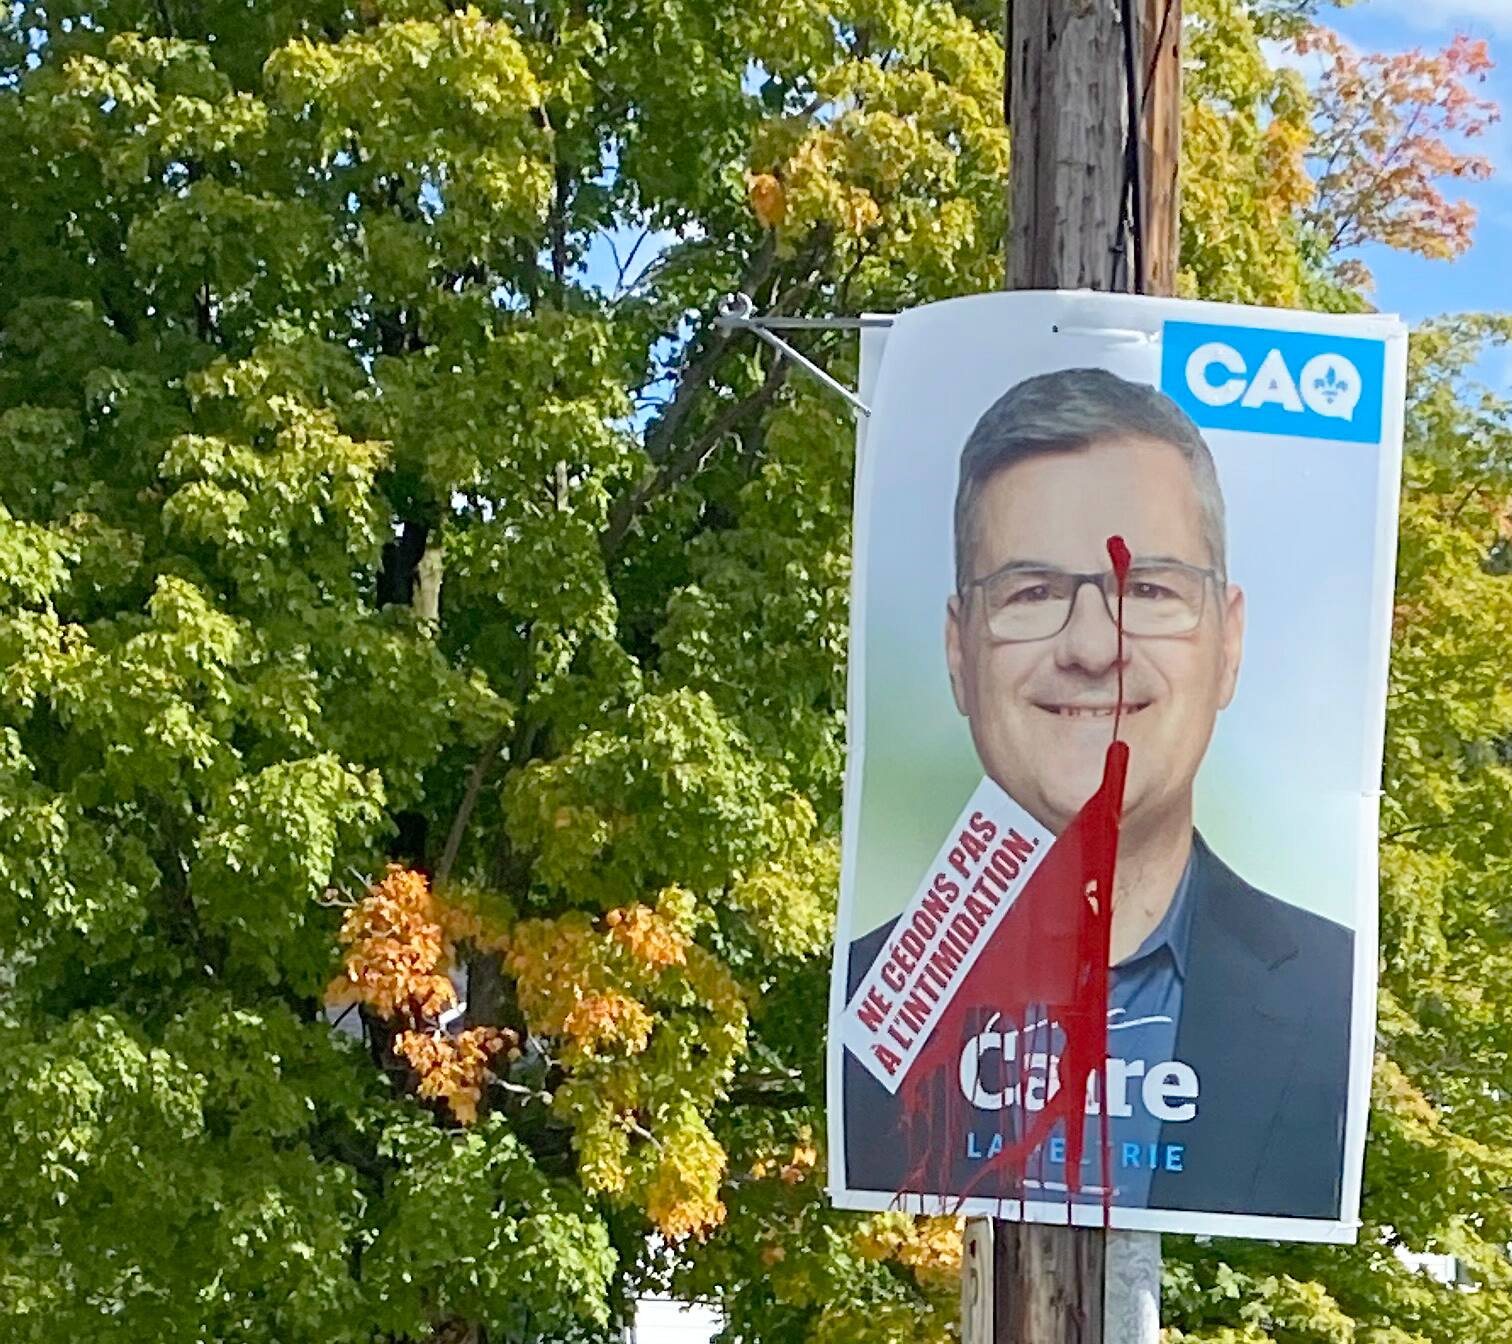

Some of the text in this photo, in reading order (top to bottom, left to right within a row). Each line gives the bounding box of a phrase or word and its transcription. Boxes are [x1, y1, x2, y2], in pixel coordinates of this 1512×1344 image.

[1185, 341, 1362, 422] CAQ
[857, 811, 997, 1033] NE CÉDONS PAS
[871, 827, 1040, 1076] À L'INTIMIDATION.
